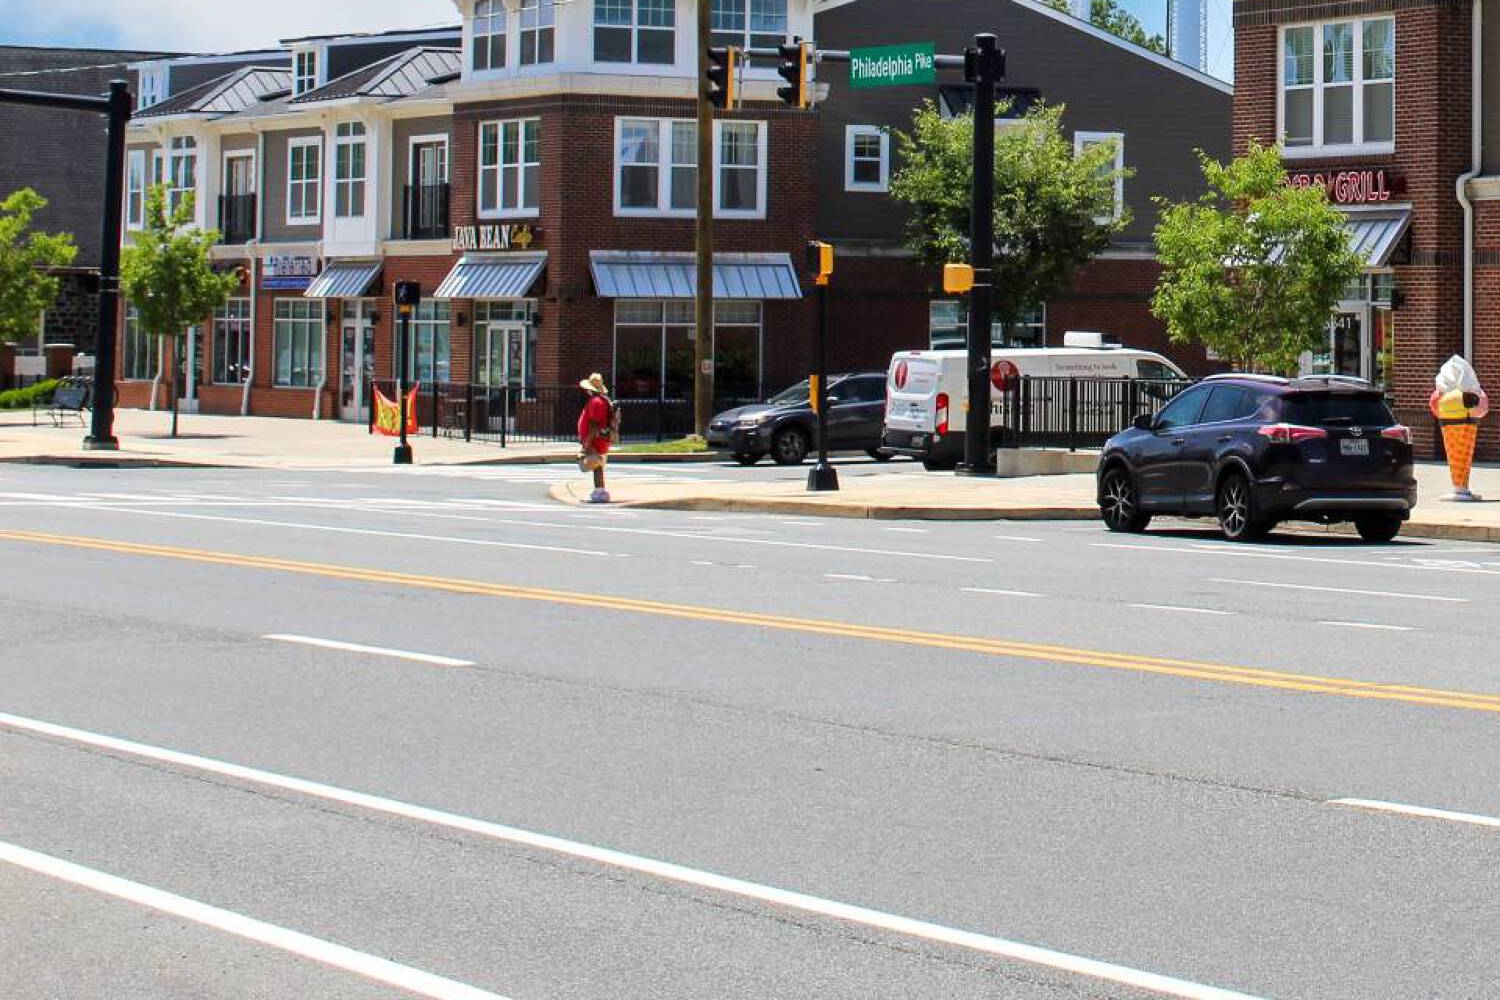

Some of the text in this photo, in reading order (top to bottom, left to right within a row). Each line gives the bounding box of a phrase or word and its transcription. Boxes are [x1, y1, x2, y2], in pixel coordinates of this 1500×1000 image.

[852, 53, 932, 79] Philadelphia Pike
[1335, 170, 1390, 201] GRILL
[479, 225, 510, 249] BEAN
